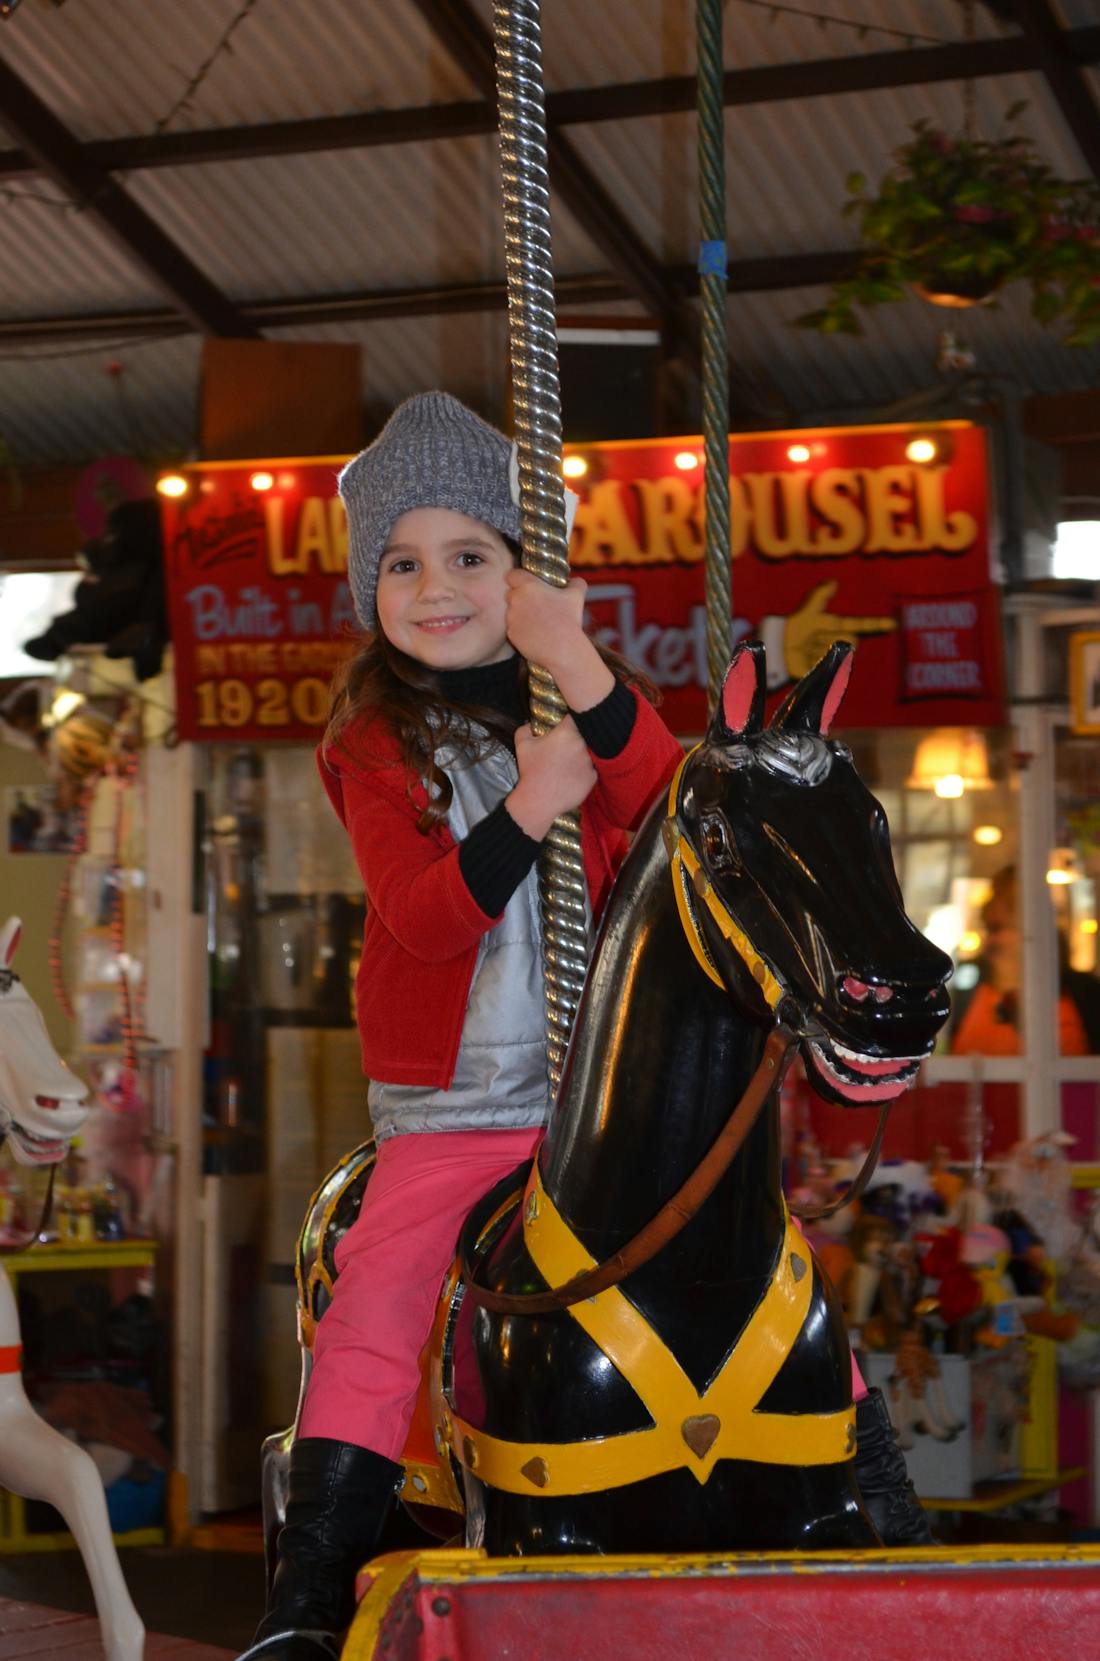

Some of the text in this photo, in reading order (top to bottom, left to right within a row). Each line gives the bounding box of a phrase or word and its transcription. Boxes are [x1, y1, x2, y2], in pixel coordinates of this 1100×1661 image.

[568, 464, 978, 566] AROUSEL
[184, 583, 284, 641] Built
[287, 588, 324, 637] in
